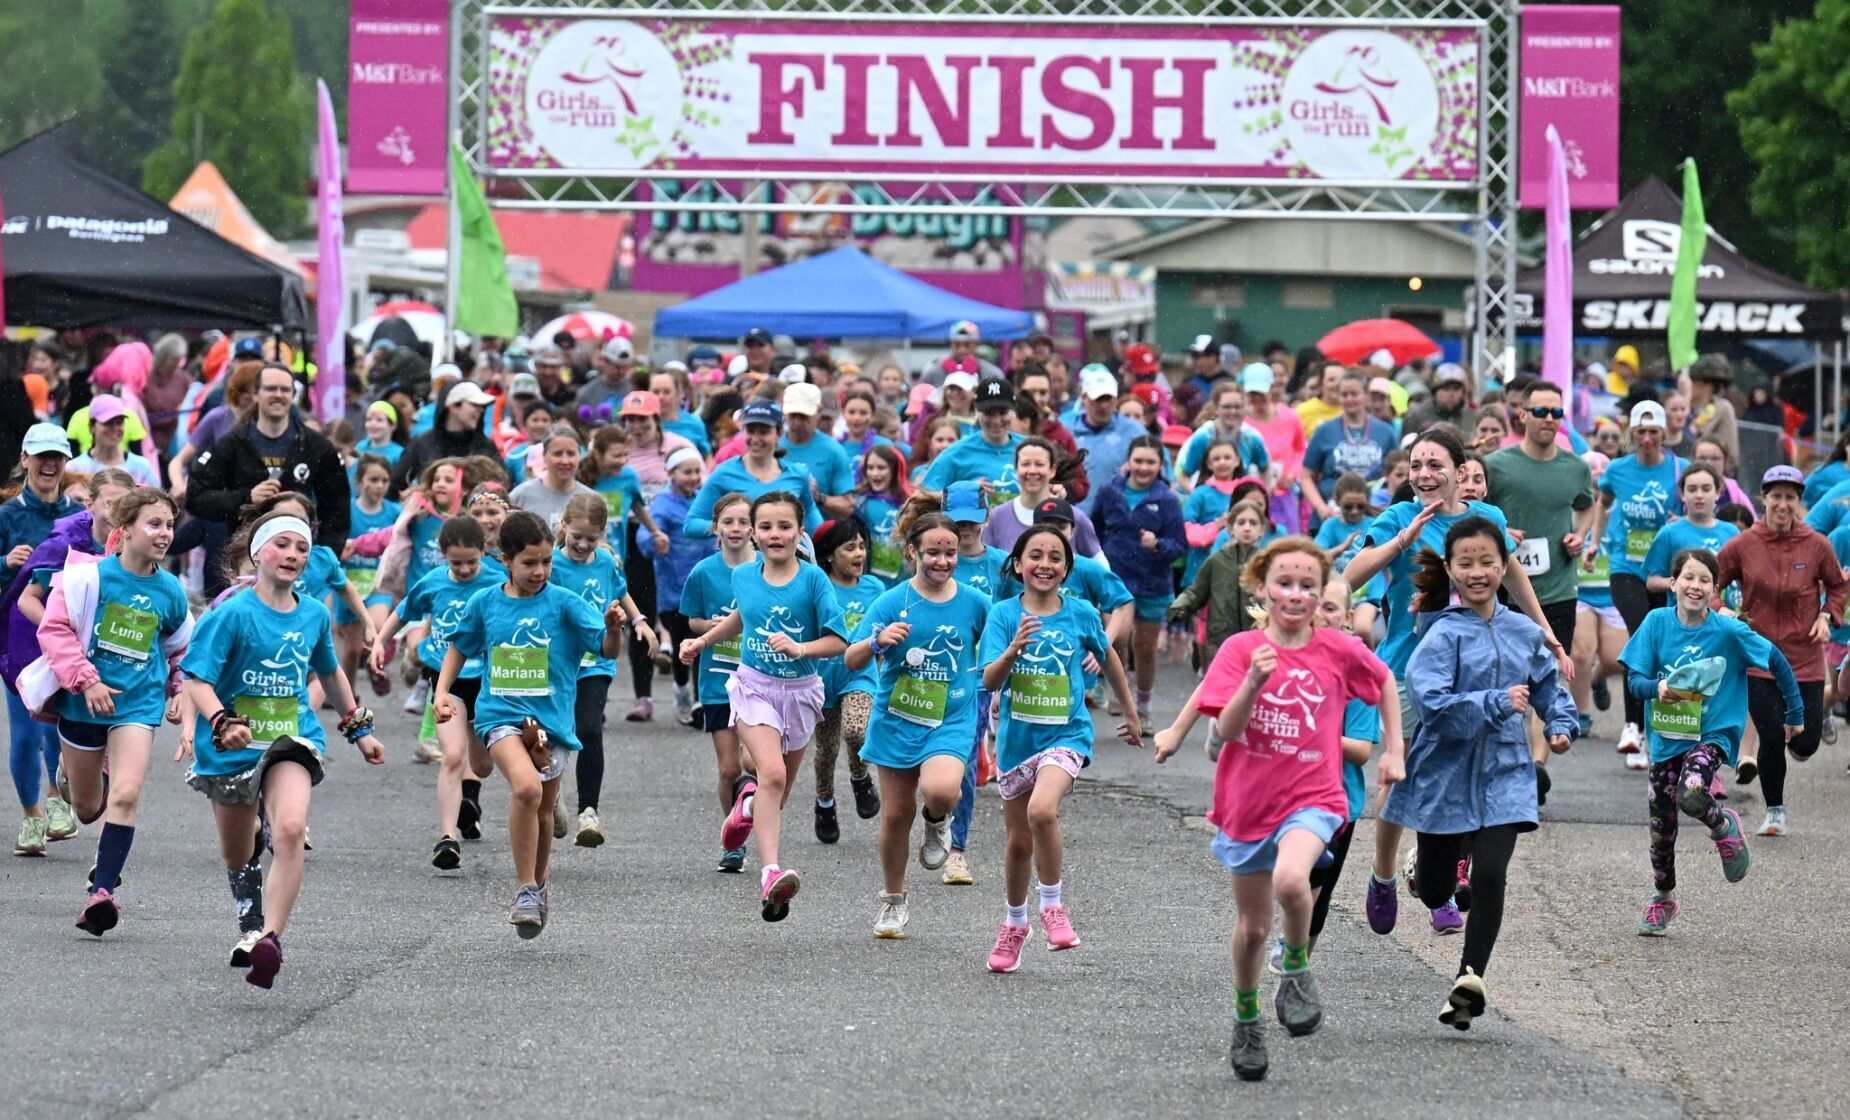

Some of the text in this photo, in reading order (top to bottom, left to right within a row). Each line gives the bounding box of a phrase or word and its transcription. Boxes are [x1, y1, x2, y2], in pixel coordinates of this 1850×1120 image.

[356, 22, 421, 35] PRESENTED
[1527, 36, 1593, 48] PRESENTED
[537, 90, 599, 110] Girls
[748, 53, 1216, 150] FINISH
[1290, 99, 1353, 120] Girls
[570, 112, 616, 127] run
[1323, 121, 1370, 137] run
[851, 183, 1010, 248] Dough
[47, 215, 169, 234] patagonia
[69, 228, 145, 243] Burlington
[1582, 300, 1806, 332] SKIACK
[1622, 501, 1649, 512] Girls
[109, 622, 144, 641] Lune
[242, 669, 287, 686] Girls
[491, 665, 546, 679] Mariana
[918, 671, 950, 682] run
[261, 684, 294, 697] run
[1011, 690, 1067, 707] Mariana
[900, 693, 933, 710] Olive
[248, 718, 294, 734] ayson
[1653, 710, 1698, 726] Rosetta
[1262, 721, 1300, 738] run
